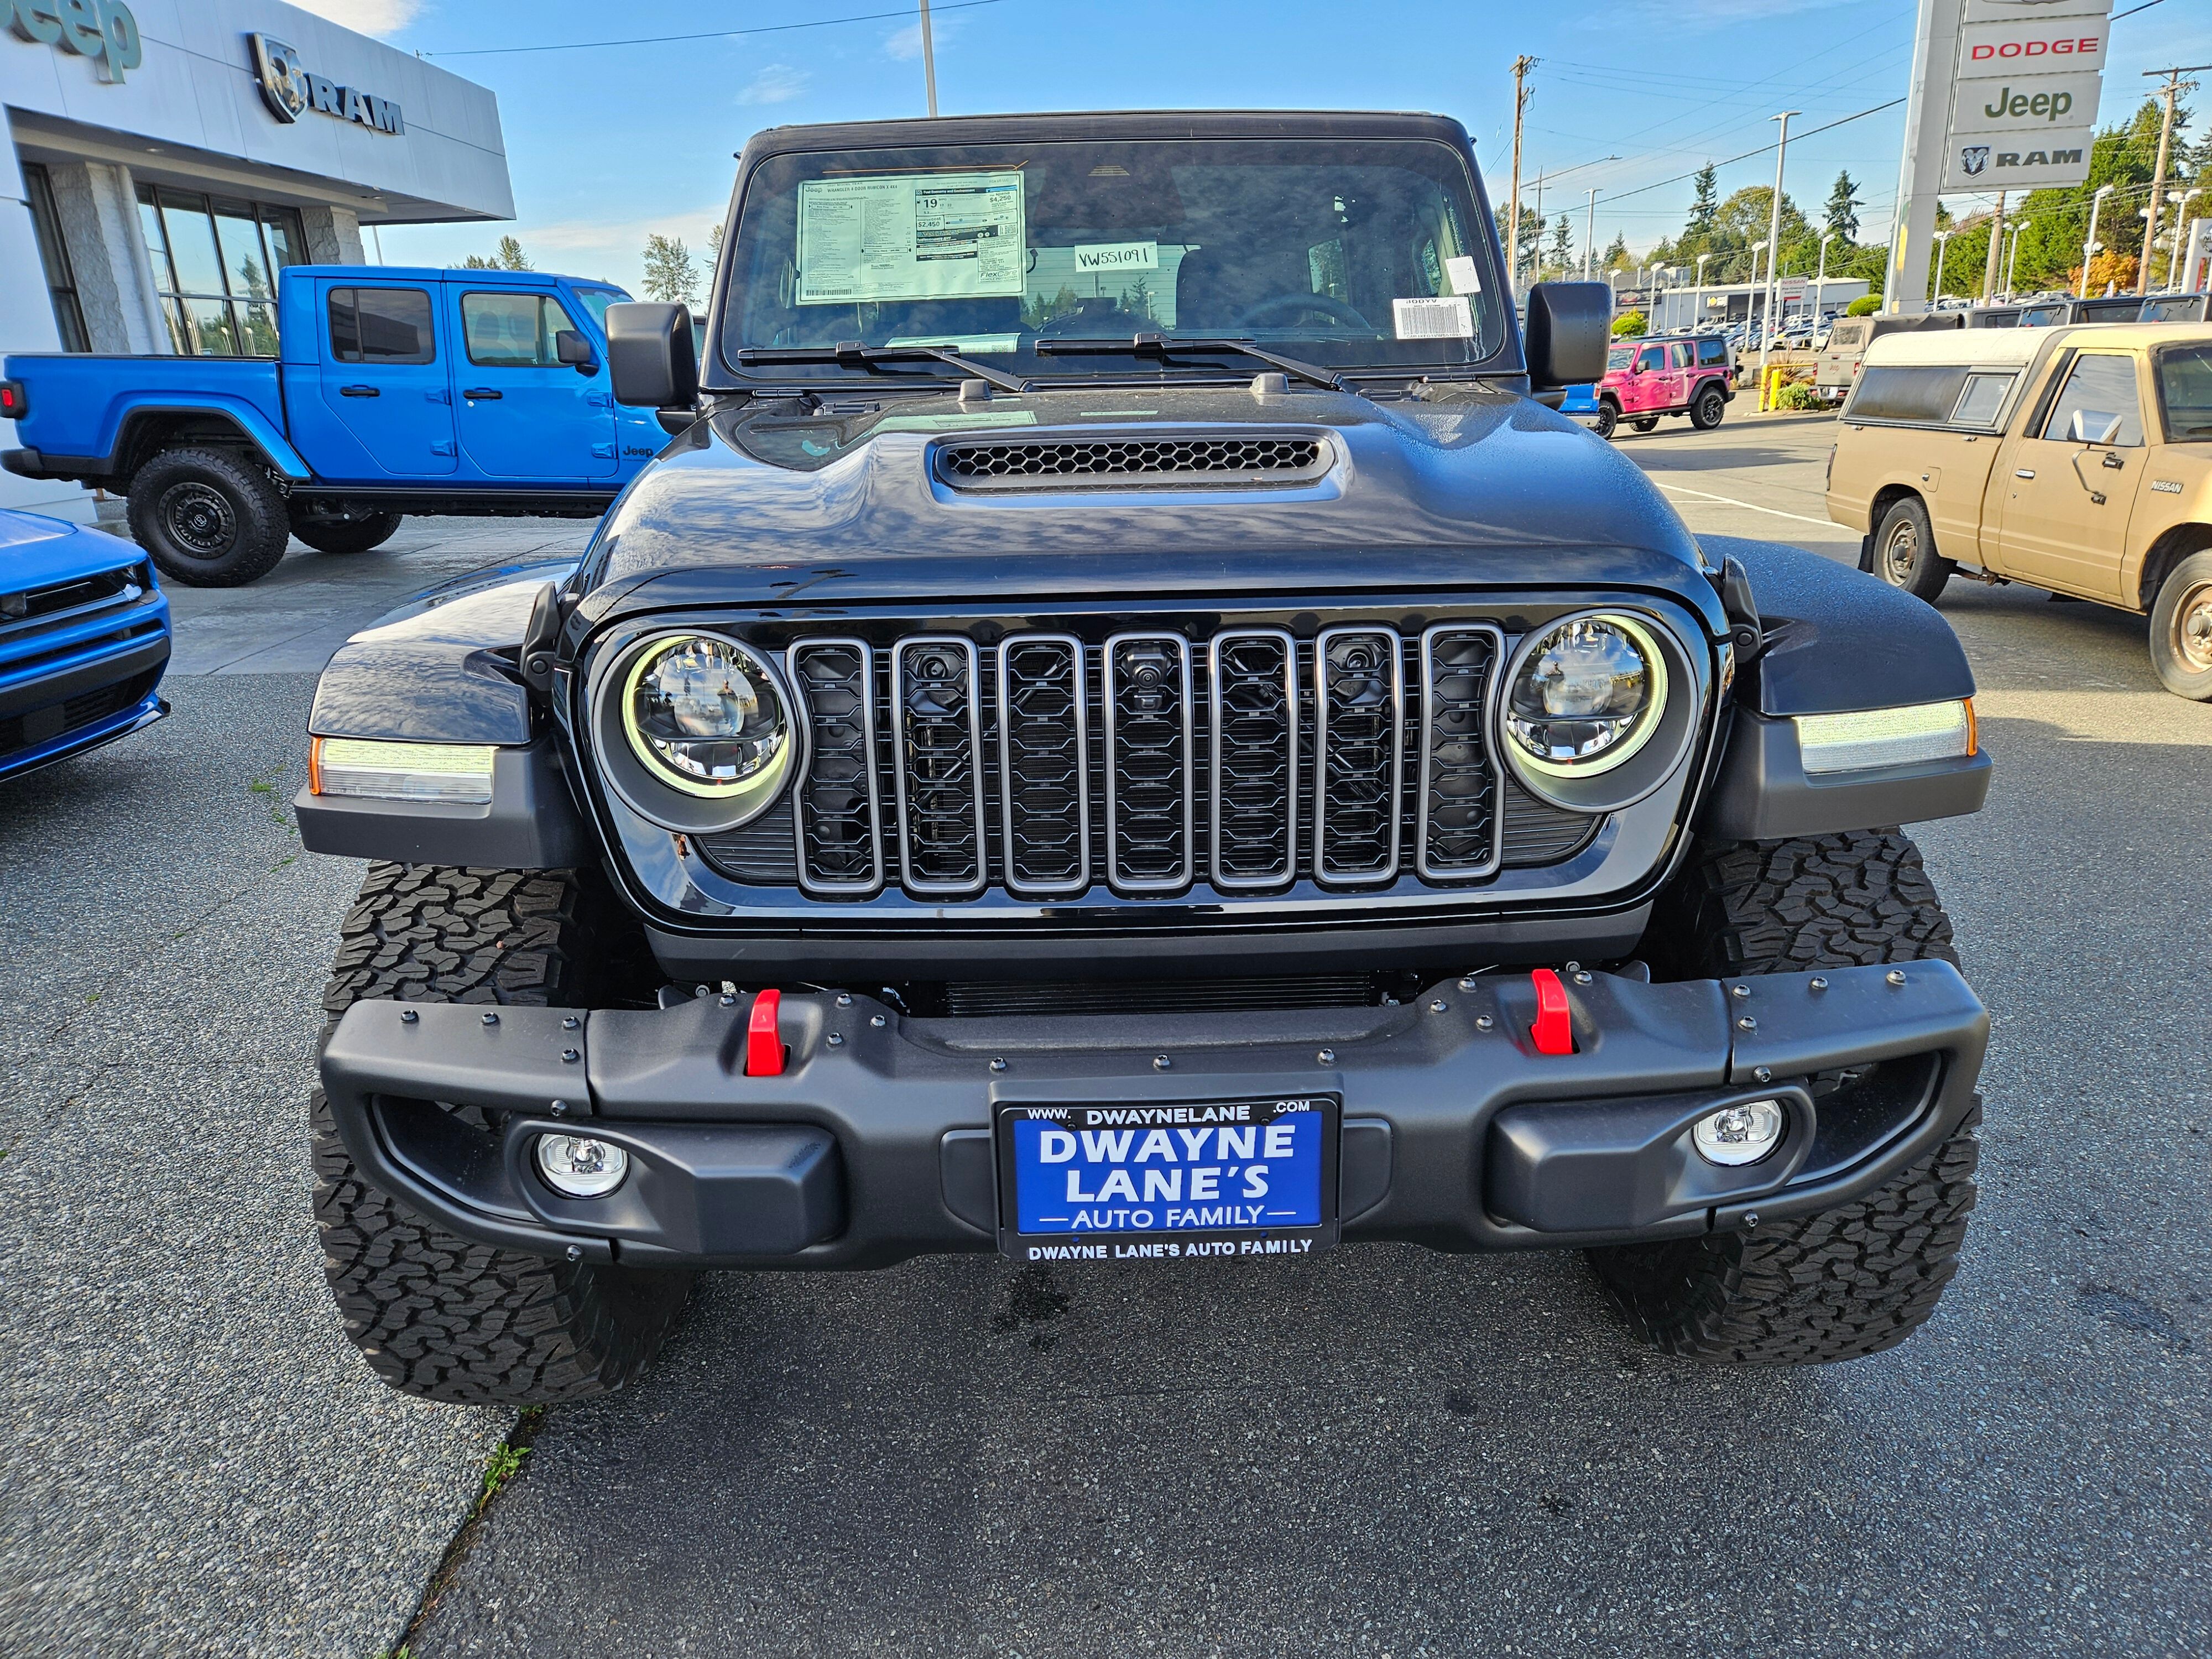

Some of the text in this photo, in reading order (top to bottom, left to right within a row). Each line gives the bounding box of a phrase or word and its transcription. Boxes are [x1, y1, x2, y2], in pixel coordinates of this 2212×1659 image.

[0, 0, 142, 84] eep
[1971, 38, 2099, 60] DODGE
[304, 72, 405, 135] RAM
[1985, 87, 2072, 122] Jeep
[1996, 149, 2083, 168] RAM
[924, 199, 937, 208] 19
[1079, 248, 1148, 267] VW551091
[623, 445, 654, 458] Jeep
[2151, 479, 2184, 494] NISSAN
[1027, 1100, 1310, 1125] WWW. DWAYNELANE .COM
[1040, 1125, 1296, 1163] DWAYNE
[1067, 1165, 1270, 1203] LANE'S
[1071, 1205, 1265, 1229] AUTO FAMILY
[1029, 1239, 1313, 1260] DWAYNE LANE'S AUTO FAMILY
